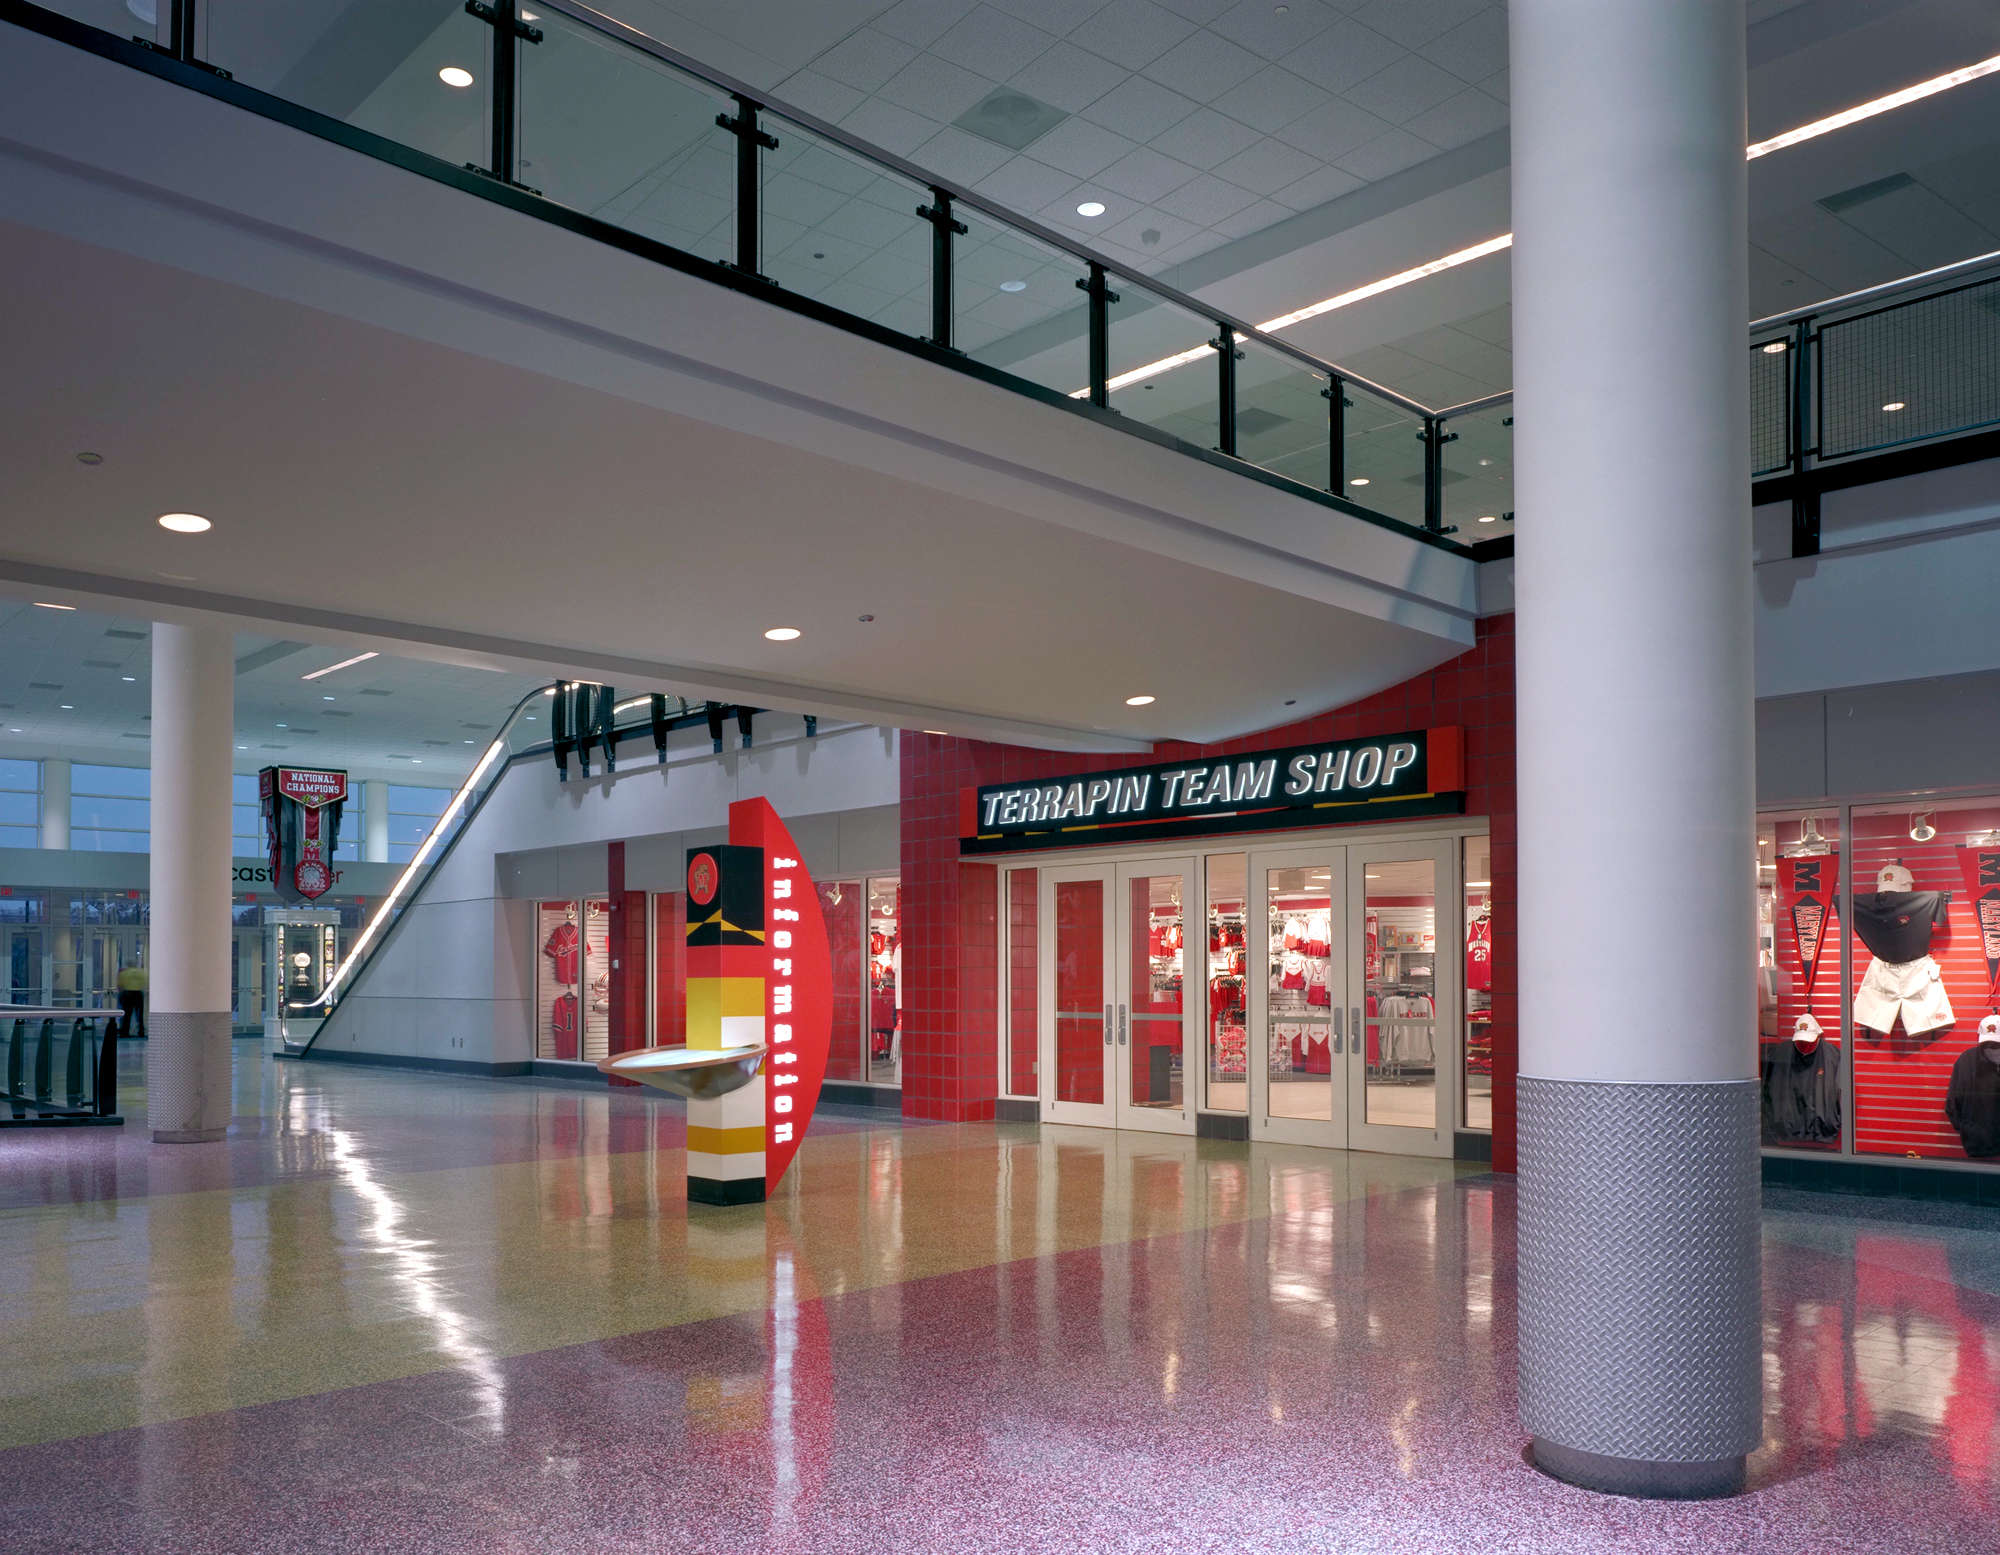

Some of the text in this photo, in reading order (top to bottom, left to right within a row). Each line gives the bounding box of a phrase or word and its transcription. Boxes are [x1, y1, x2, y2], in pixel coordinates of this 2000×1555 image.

[286, 783, 340, 794] CHAMPIONS
[291, 773, 335, 784] NATIONAL
[982, 743, 1418, 826] TERRAPIN TEAM SHOP
[1794, 861, 1821, 892] M
[1794, 905, 1822, 961] MARYLAND
[1474, 949, 1486, 962] 25
[774, 857, 799, 1144] information
